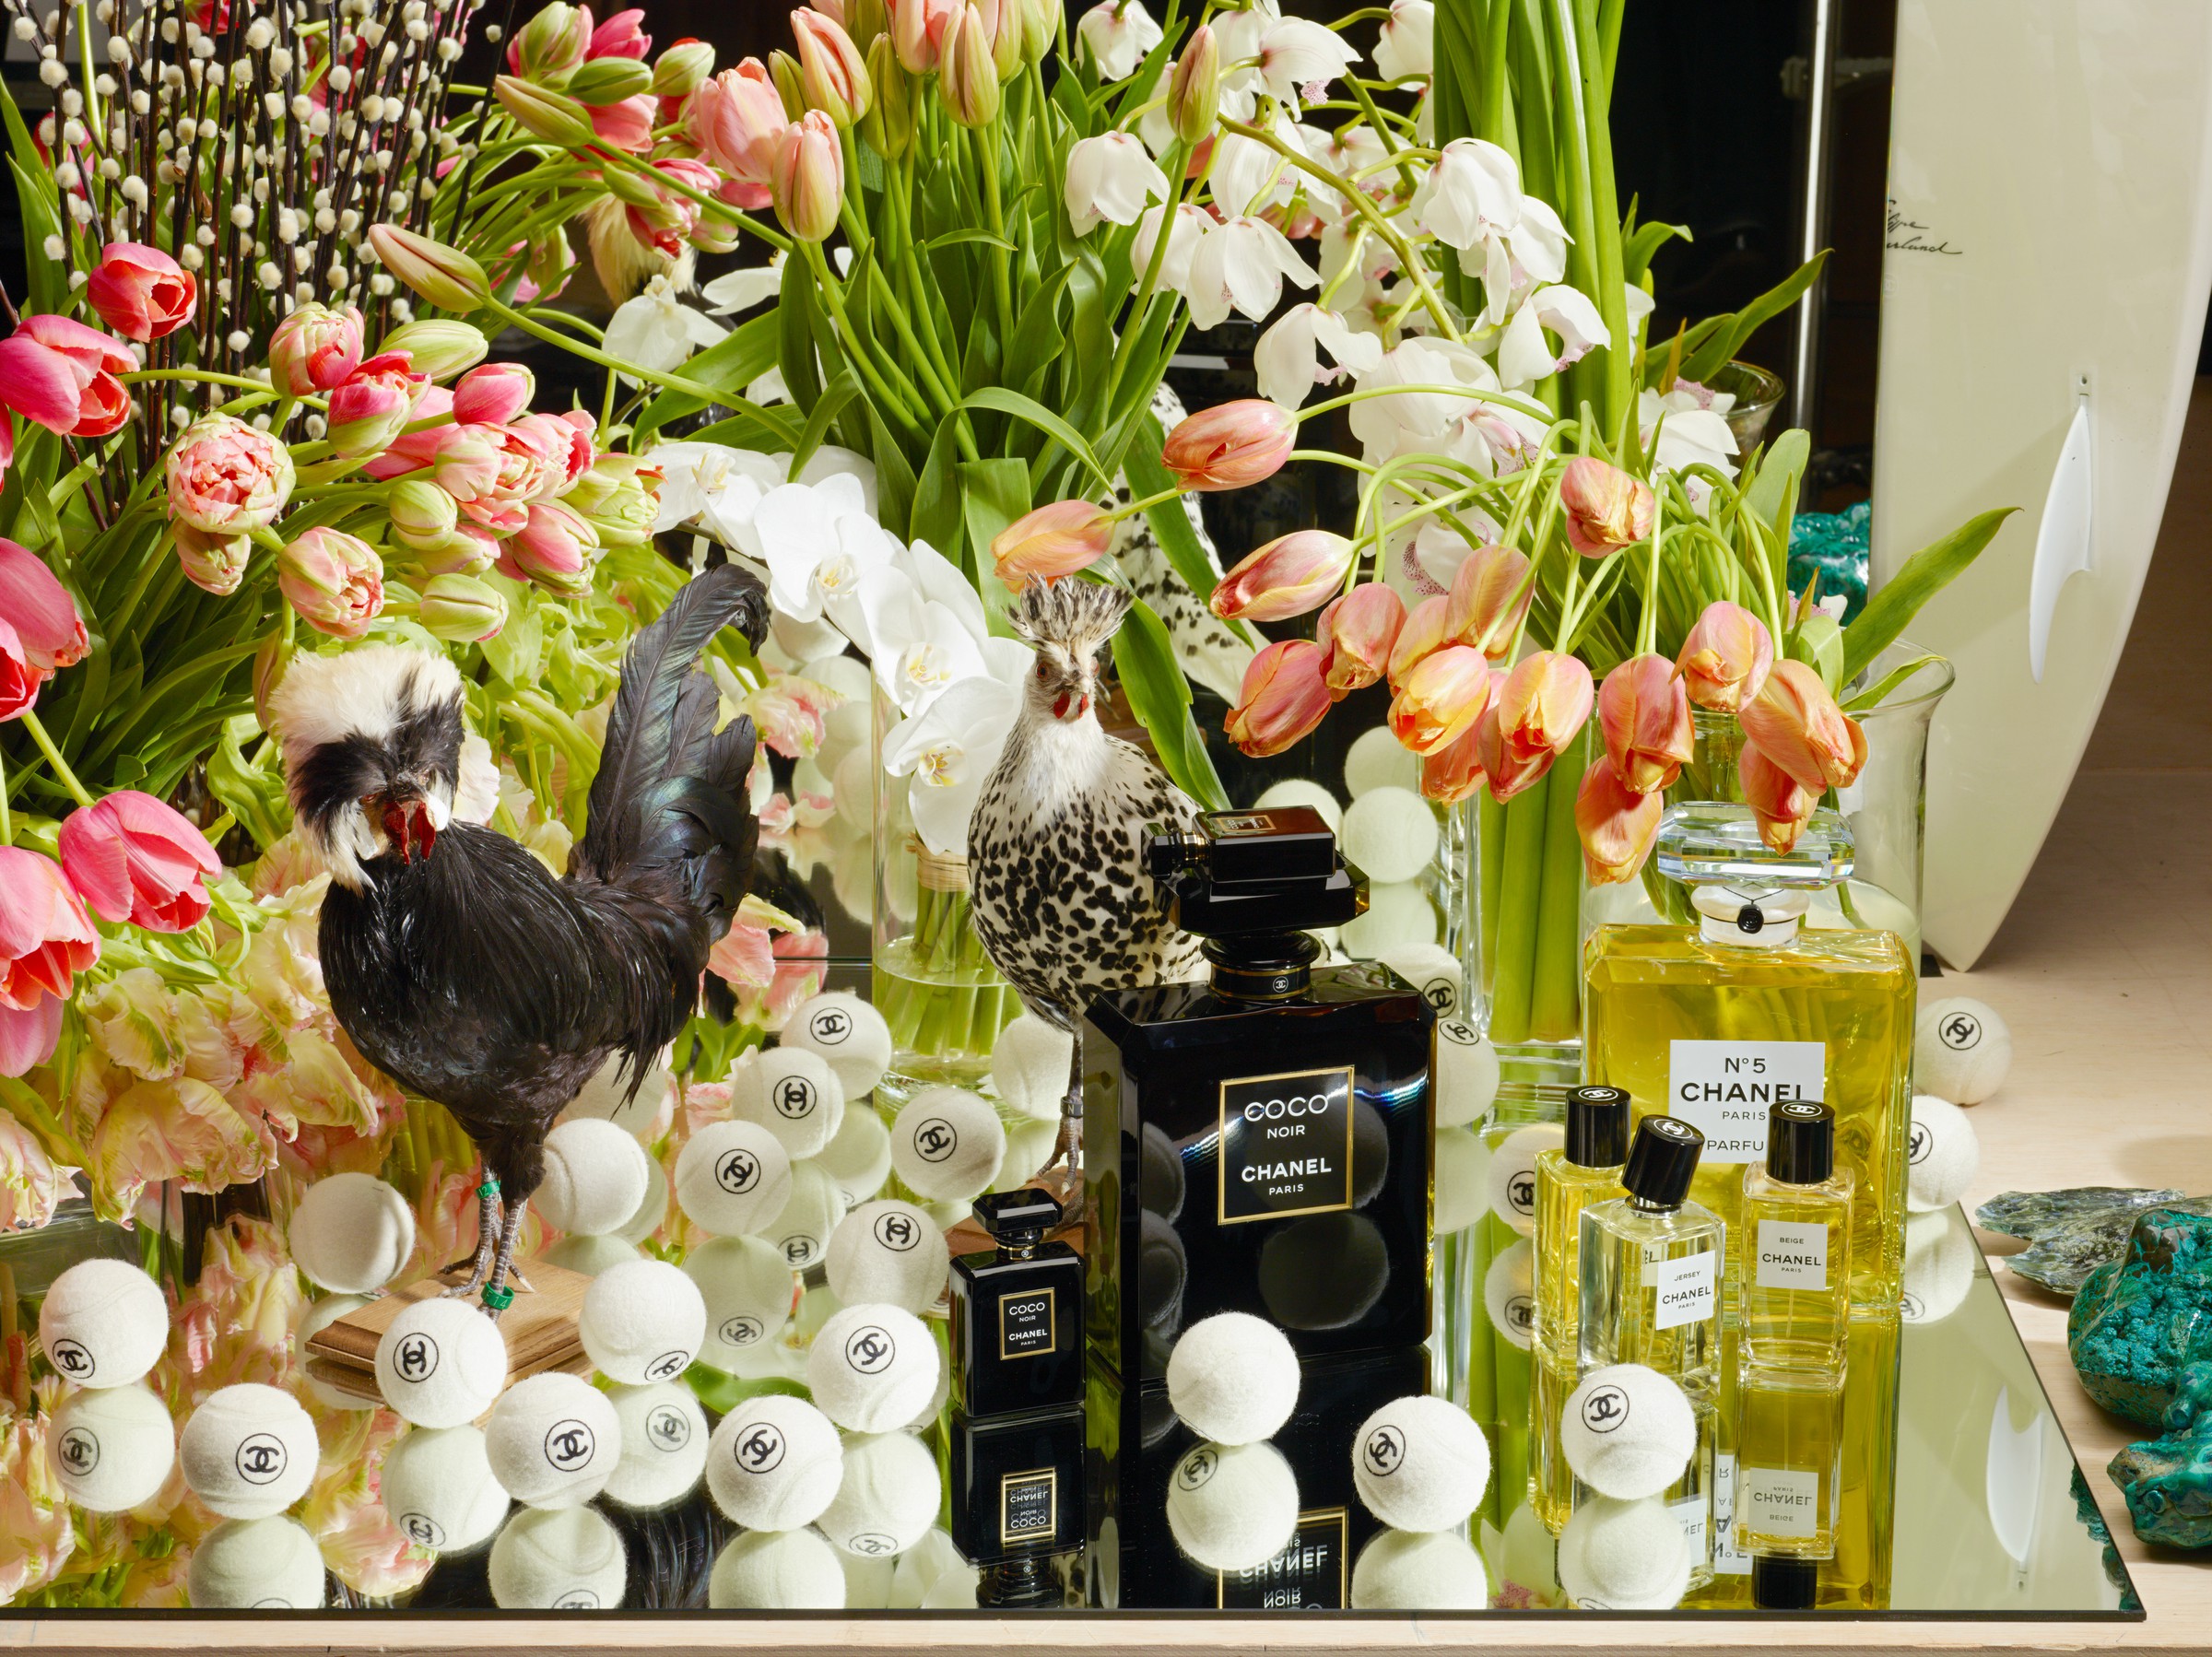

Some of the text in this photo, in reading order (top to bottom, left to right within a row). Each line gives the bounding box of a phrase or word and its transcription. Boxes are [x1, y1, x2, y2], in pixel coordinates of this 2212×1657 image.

[1244, 1094, 1328, 1122] COCO
[1722, 1111, 1767, 1121] PARIS
[1266, 1124, 1306, 1139] NOIR
[1707, 1140, 1764, 1151] PARFU
[1241, 1158, 1332, 1182] CHANEL
[1268, 1183, 1304, 1195] PARIS
[1779, 1237, 1805, 1245] BEIGE
[1761, 1253, 1821, 1266] CHANEL
[1674, 1270, 1700, 1282] JERSEY
[1662, 1286, 1712, 1305] CHANEL
[1008, 1301, 1046, 1316] COCO
[1677, 1301, 1696, 1310] PARIS
[1008, 1328, 1048, 1341] CHANEL
